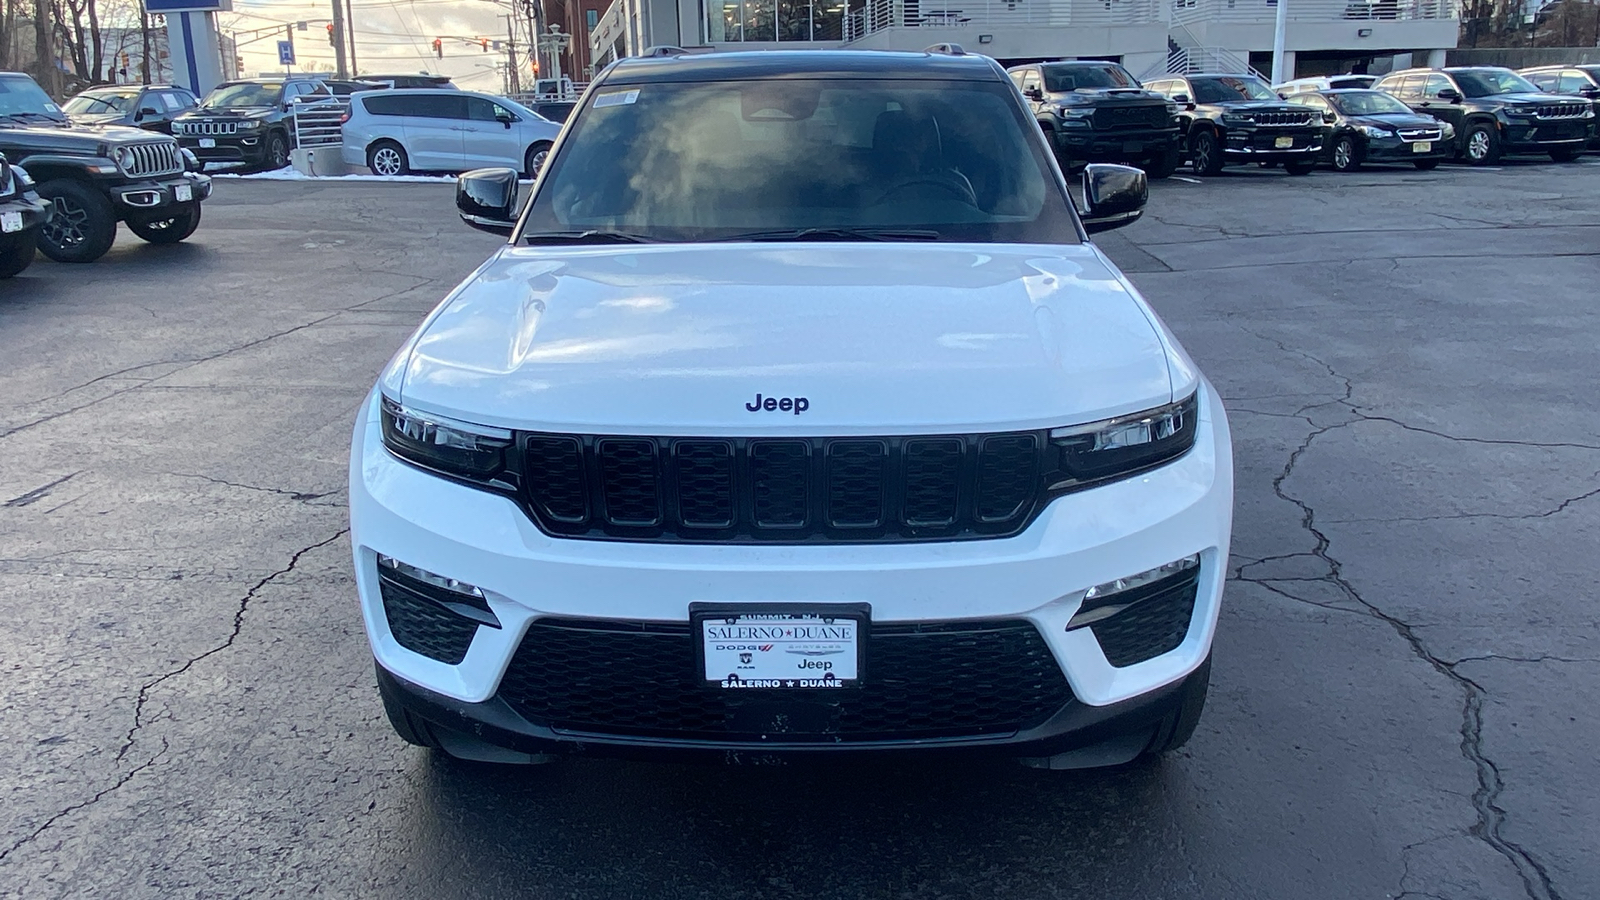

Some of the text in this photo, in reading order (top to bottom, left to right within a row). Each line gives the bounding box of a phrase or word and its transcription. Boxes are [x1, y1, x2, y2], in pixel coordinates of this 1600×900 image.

[281, 45, 292, 58] H
[745, 393, 809, 415] Jeep
[708, 627, 852, 639] SALERNO DUANE
[797, 658, 833, 671] Jeep
[721, 679, 843, 688] SALERNO DUANE
